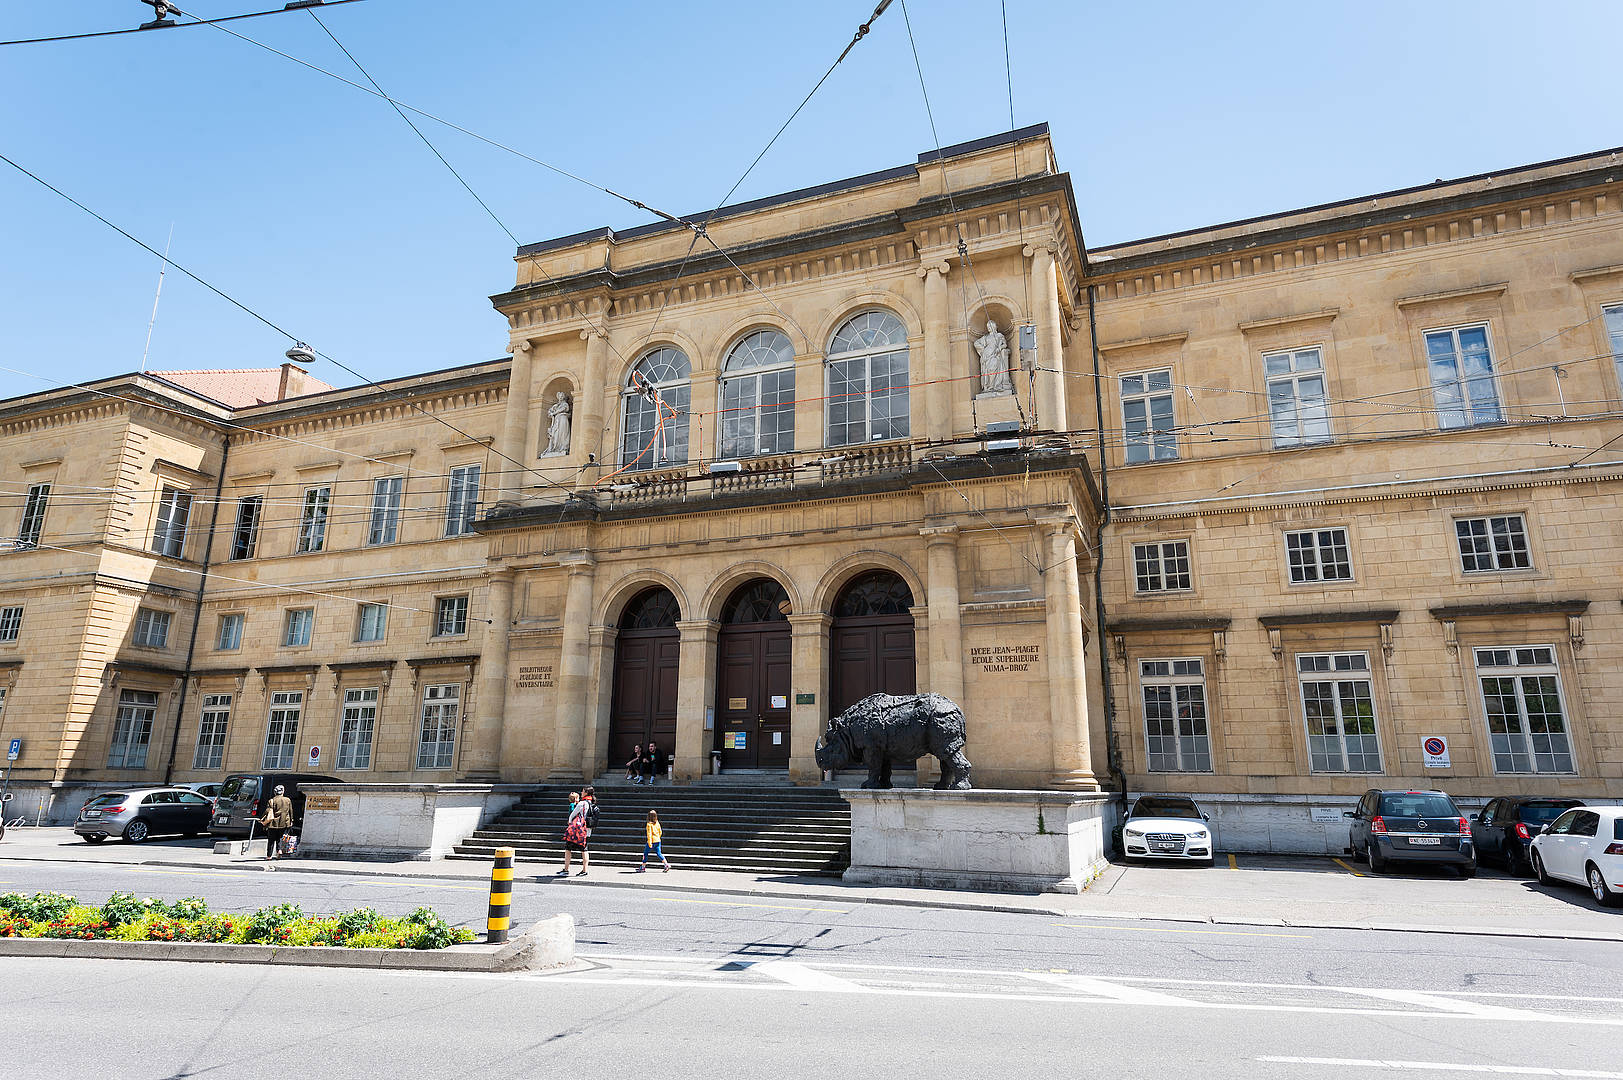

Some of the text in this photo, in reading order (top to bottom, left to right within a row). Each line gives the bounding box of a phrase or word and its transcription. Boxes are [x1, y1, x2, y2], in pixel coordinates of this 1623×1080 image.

[970, 645, 1040, 656] LYCEE JEAN-PIAGET
[972, 654, 1040, 664] ECOLE SUPERIEURE
[983, 664, 1029, 672] NUMA-DROZ
[519, 673, 543, 681] PUBLIQUE
[12, 741, 18, 753] P
